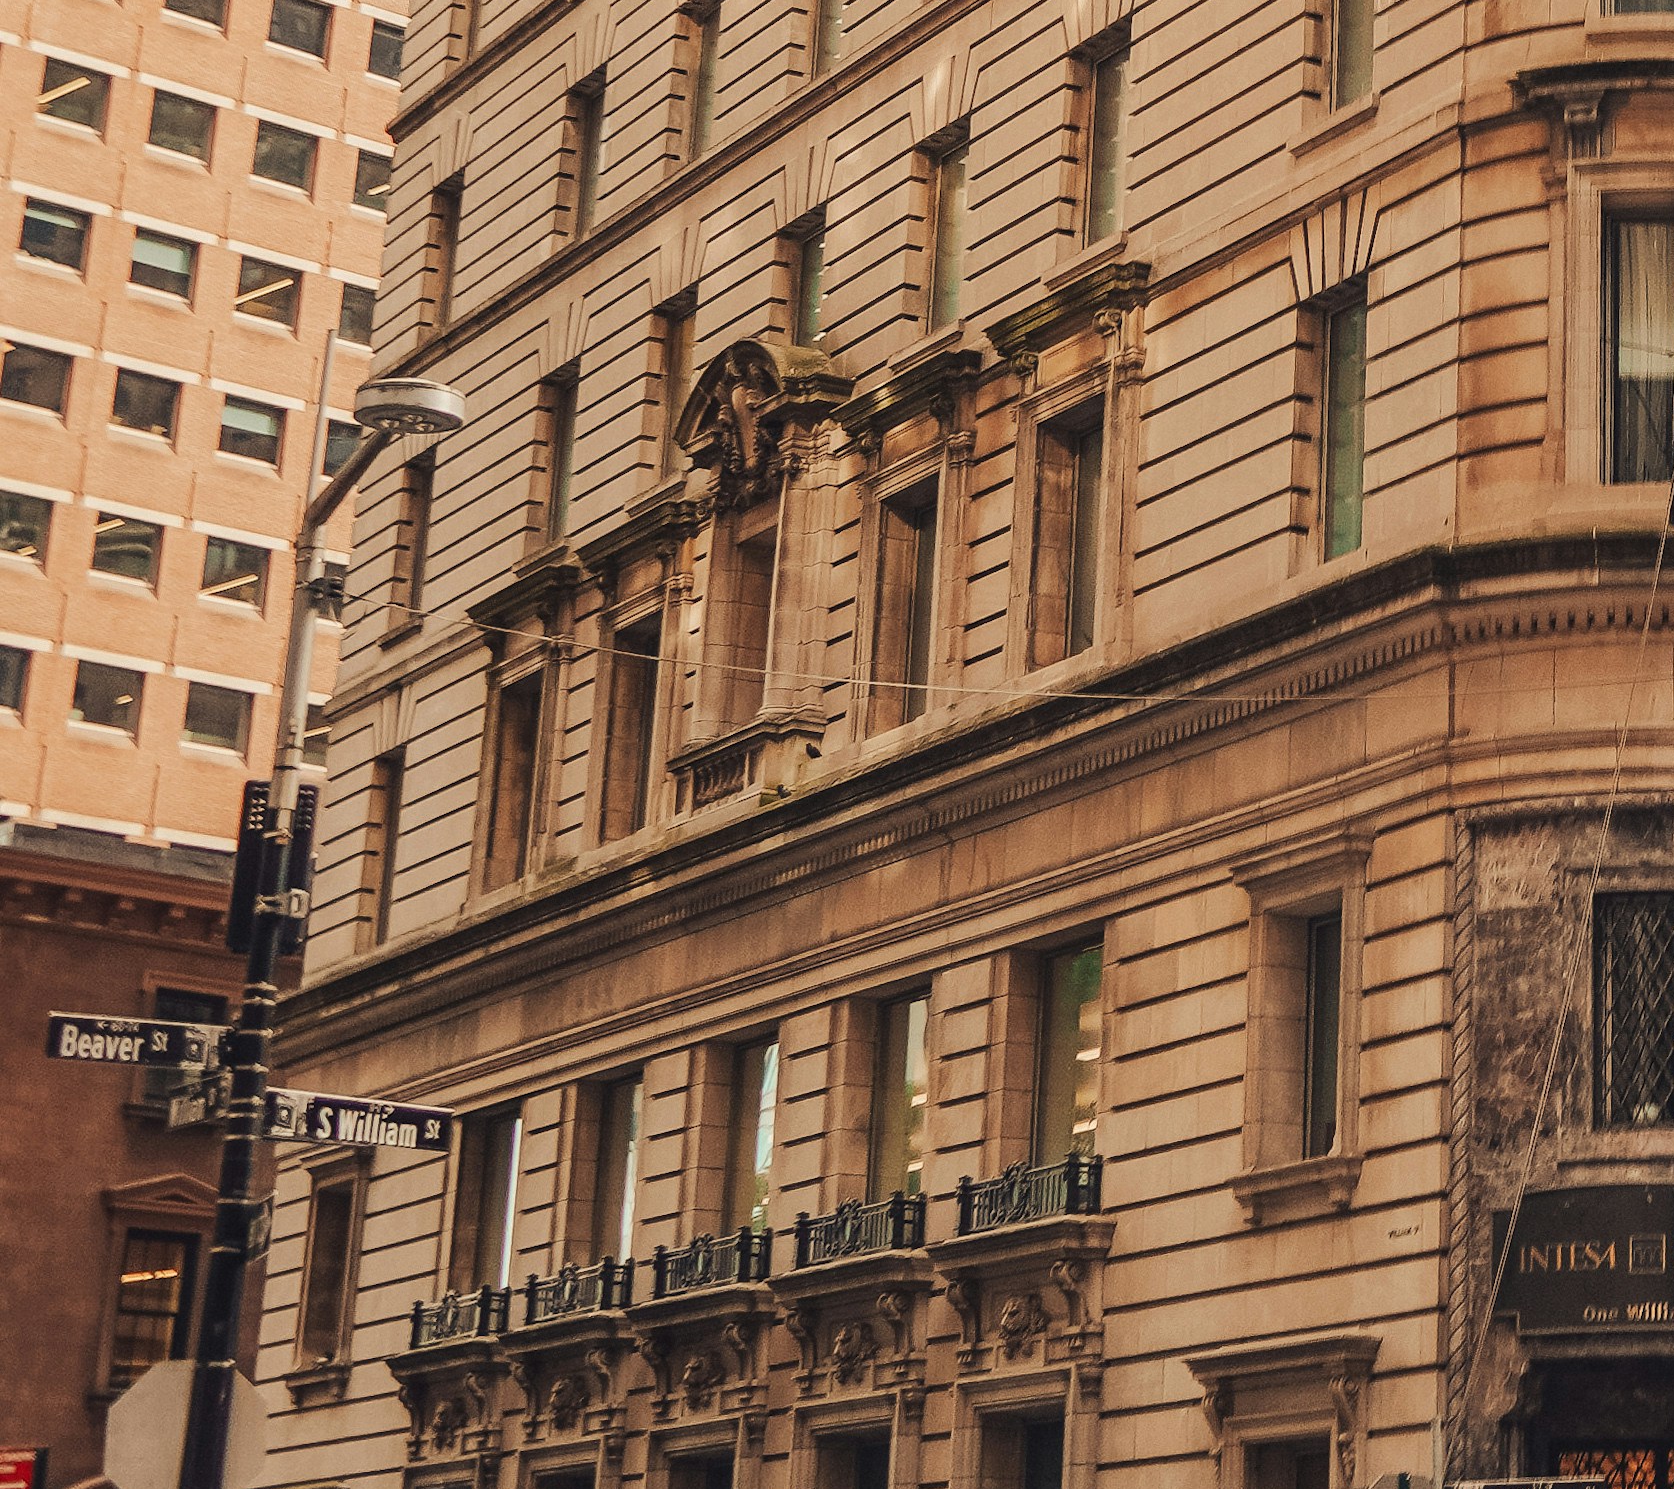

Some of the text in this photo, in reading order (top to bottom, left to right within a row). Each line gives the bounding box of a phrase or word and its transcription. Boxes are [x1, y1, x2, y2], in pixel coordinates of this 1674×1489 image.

[59, 1024, 169, 1062] Beaver St
[316, 1106, 334, 1139] S
[338, 1108, 418, 1148] William
[424, 1119, 441, 1140] St
[1519, 1239, 1617, 1272] INTESA
[1582, 1304, 1619, 1322] One
